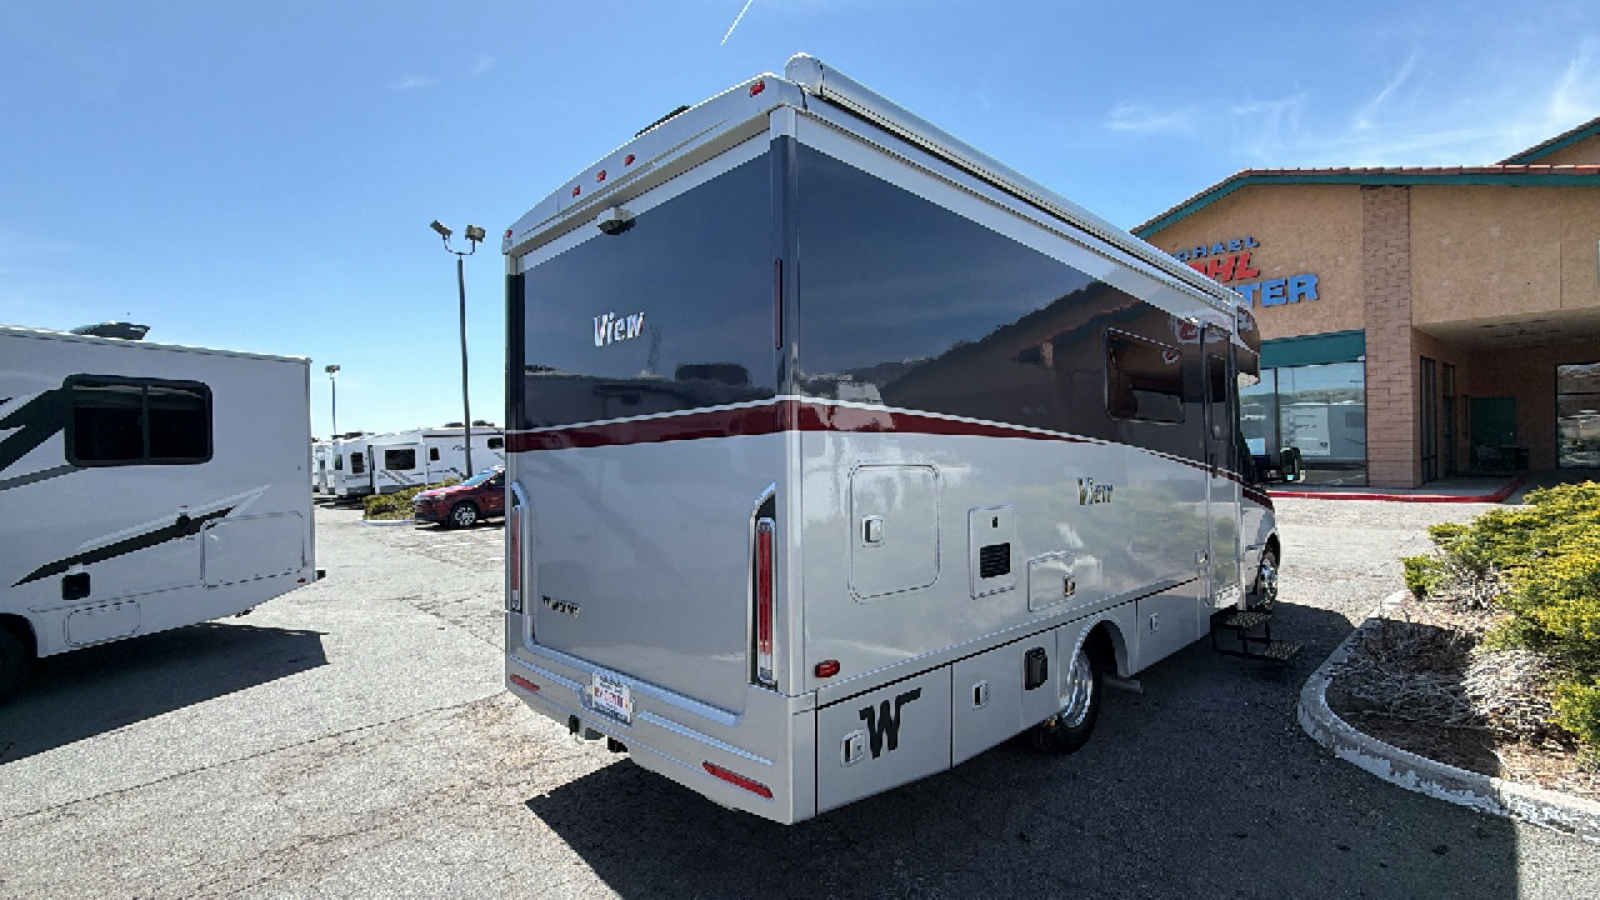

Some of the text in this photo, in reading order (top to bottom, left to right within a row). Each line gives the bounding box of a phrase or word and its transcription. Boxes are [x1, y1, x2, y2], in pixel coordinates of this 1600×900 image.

[1174, 236, 1260, 261] CHAEL
[1233, 273, 1318, 308] TER
[593, 311, 645, 347] View
